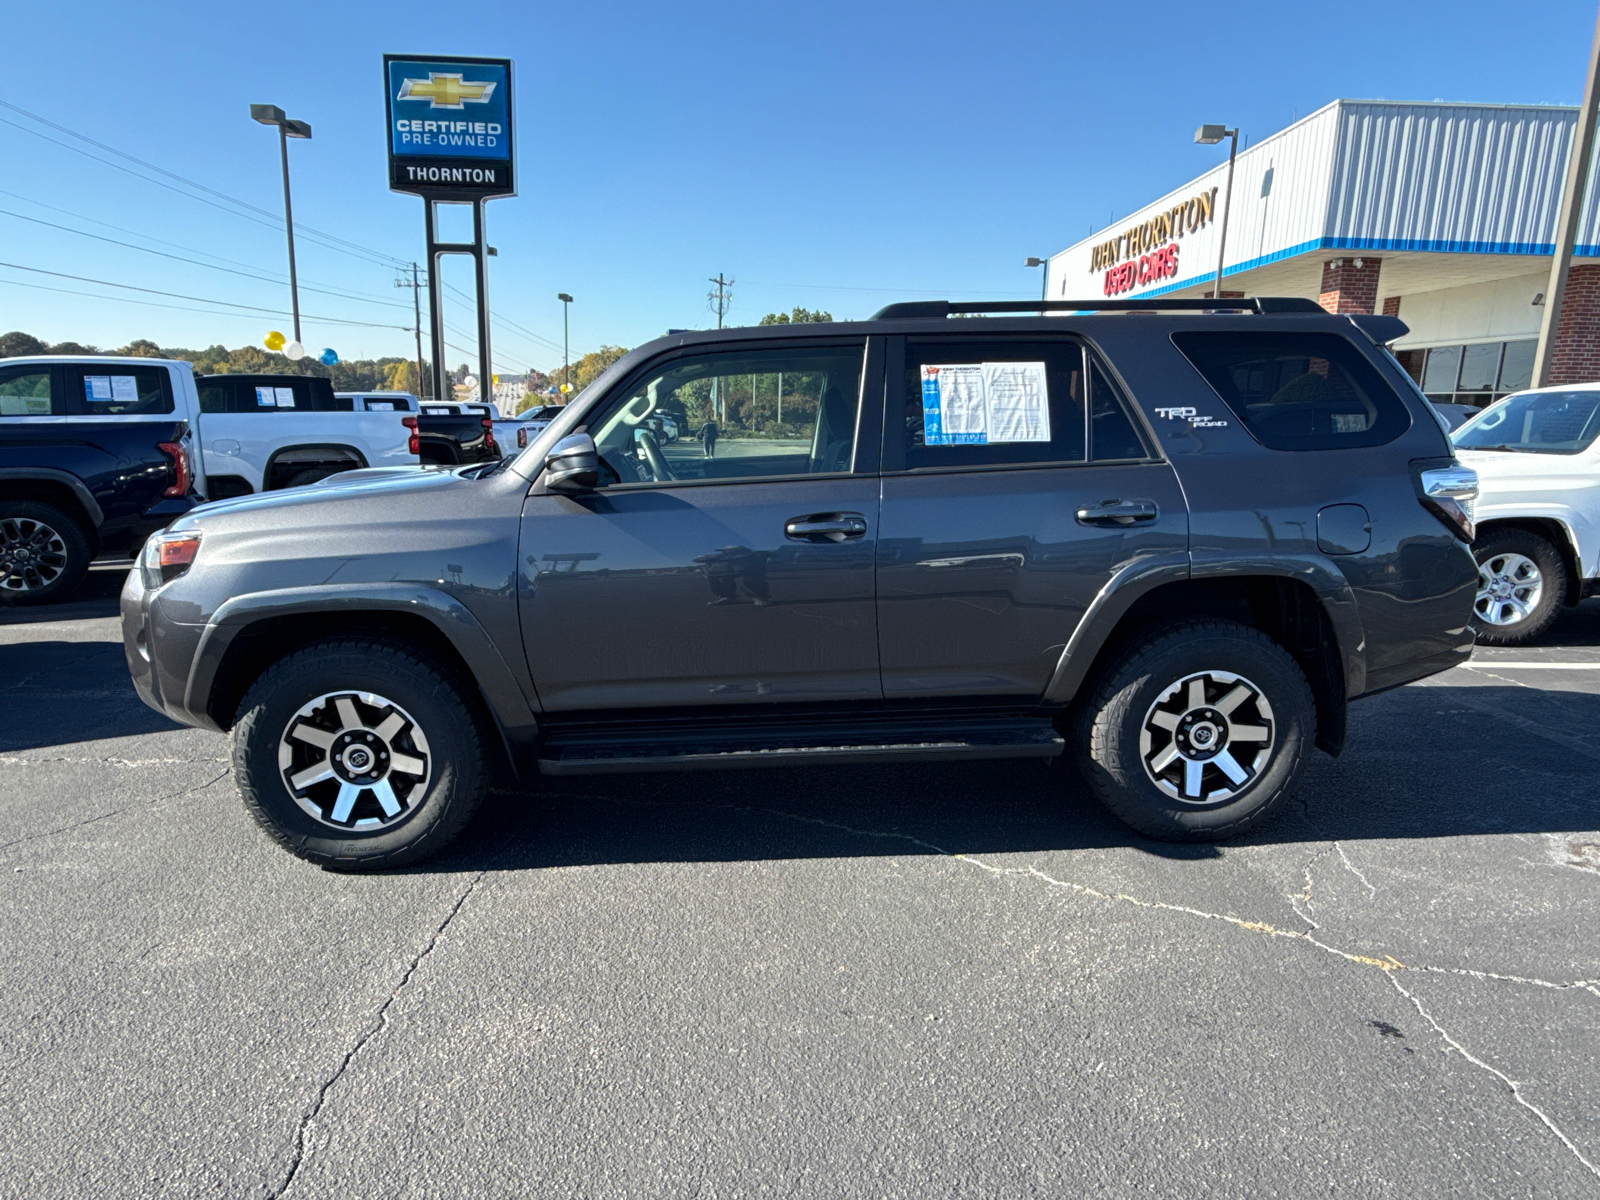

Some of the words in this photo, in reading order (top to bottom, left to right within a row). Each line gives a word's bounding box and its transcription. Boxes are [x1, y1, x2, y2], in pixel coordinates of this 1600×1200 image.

[396, 119, 502, 135] CERTIFIED
[402, 133, 497, 147] PRE-OWNED
[406, 166, 496, 183] THORNTON
[1089, 235, 1122, 274] JOHN
[1122, 186, 1218, 260] THORNTON
[1103, 260, 1137, 297] USED
[1136, 242, 1180, 286] CARS
[1154, 406, 1197, 420] TRD
